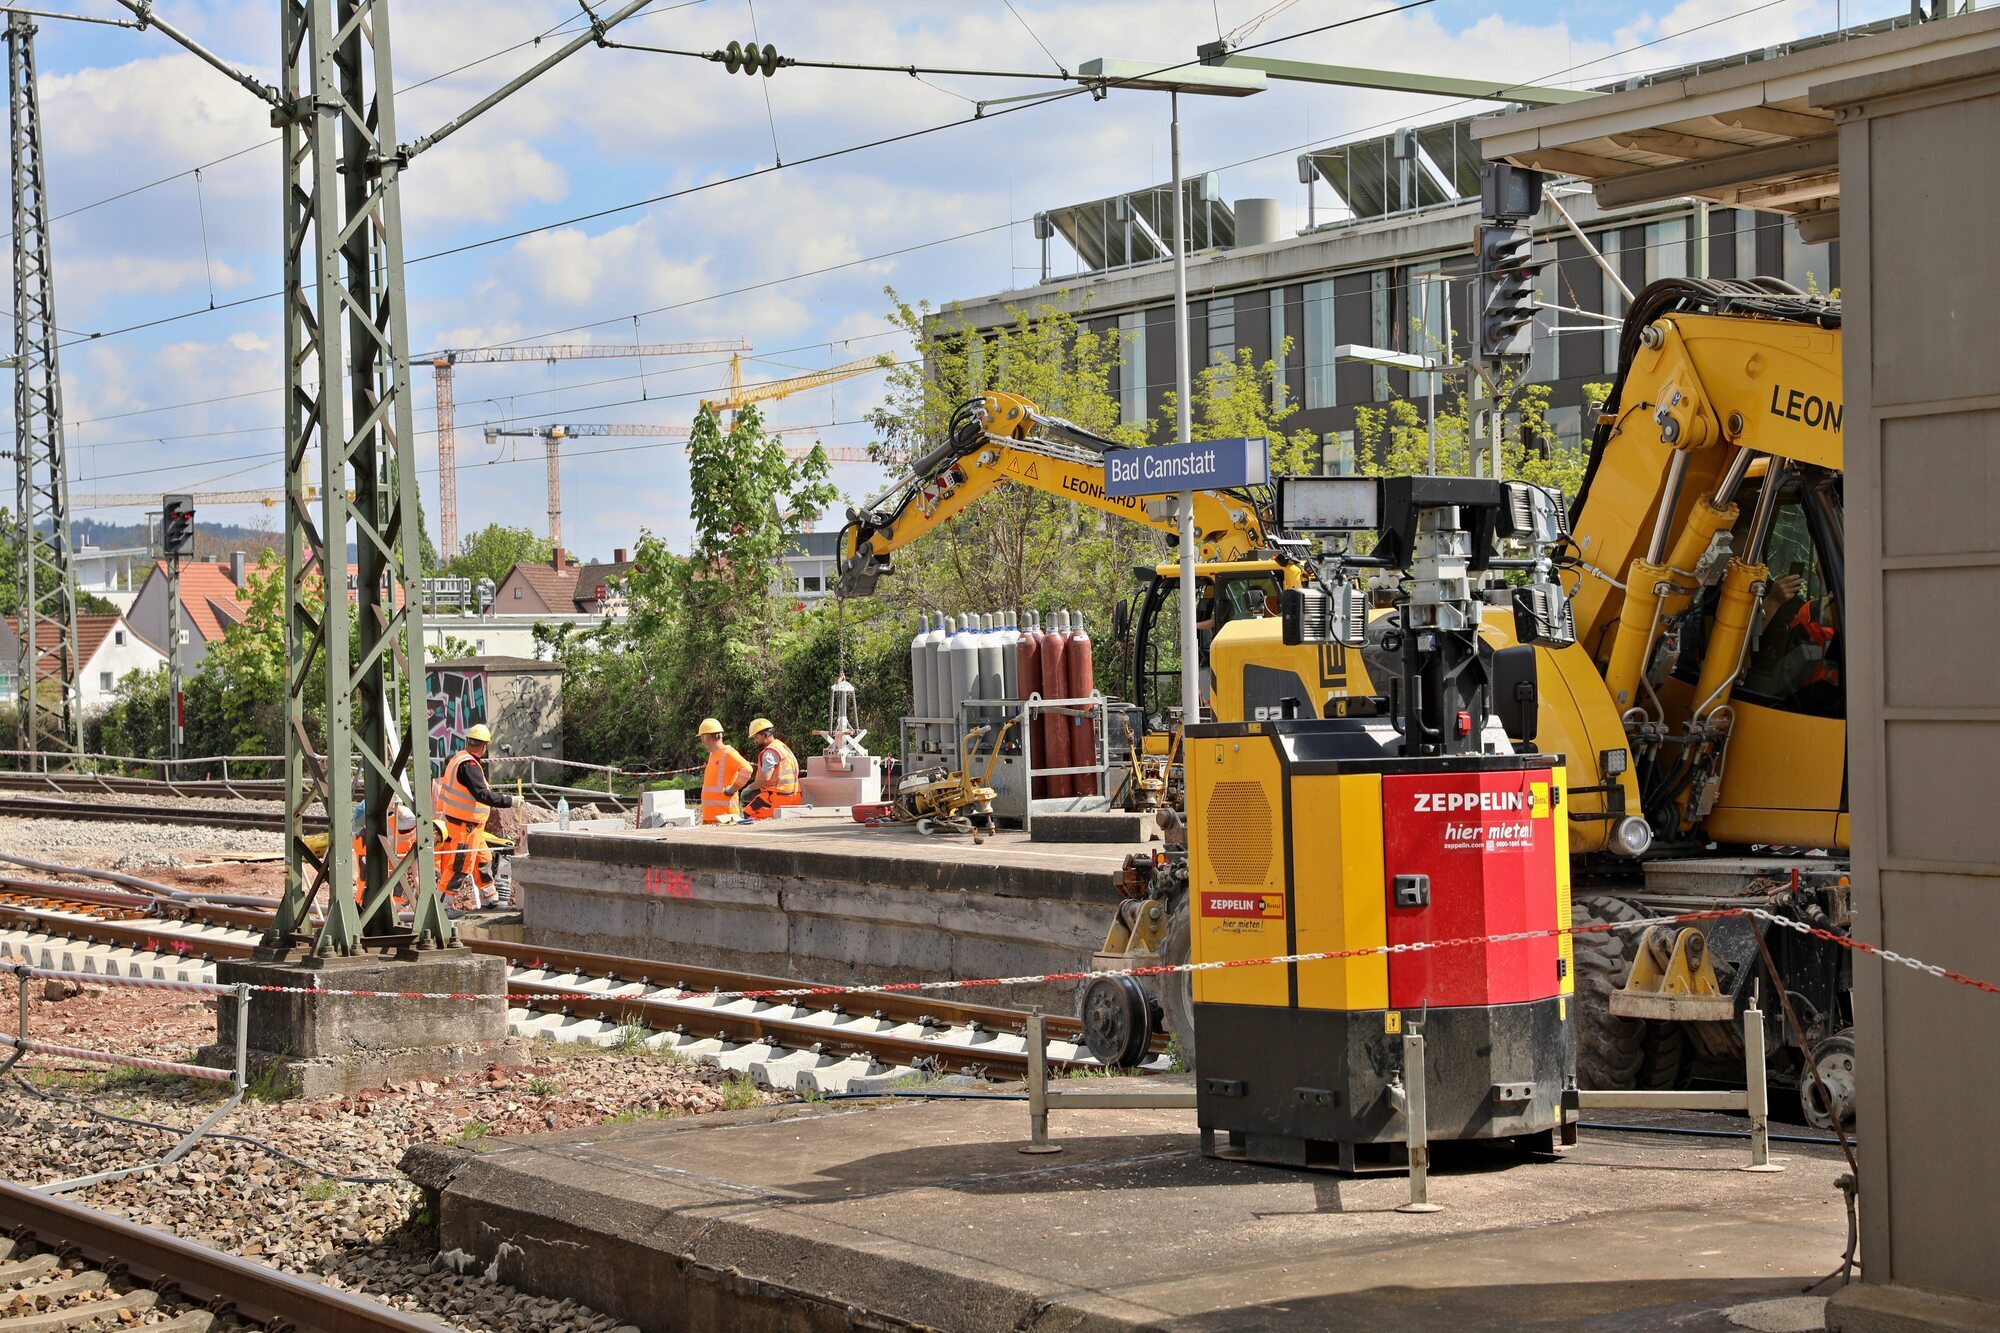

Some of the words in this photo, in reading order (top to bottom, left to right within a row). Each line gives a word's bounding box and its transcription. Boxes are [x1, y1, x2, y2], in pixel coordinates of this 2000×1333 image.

[1111, 456, 1140, 483] Bad
[1143, 449, 1216, 480] Cannstatt
[1413, 791, 1524, 812] ZEPPELIN
[1444, 822, 1483, 840] hier
[1443, 842, 1485, 850] zeppelin.com
[1210, 899, 1254, 911] ZEPPELIN
[1222, 919, 1236, 929] hier
